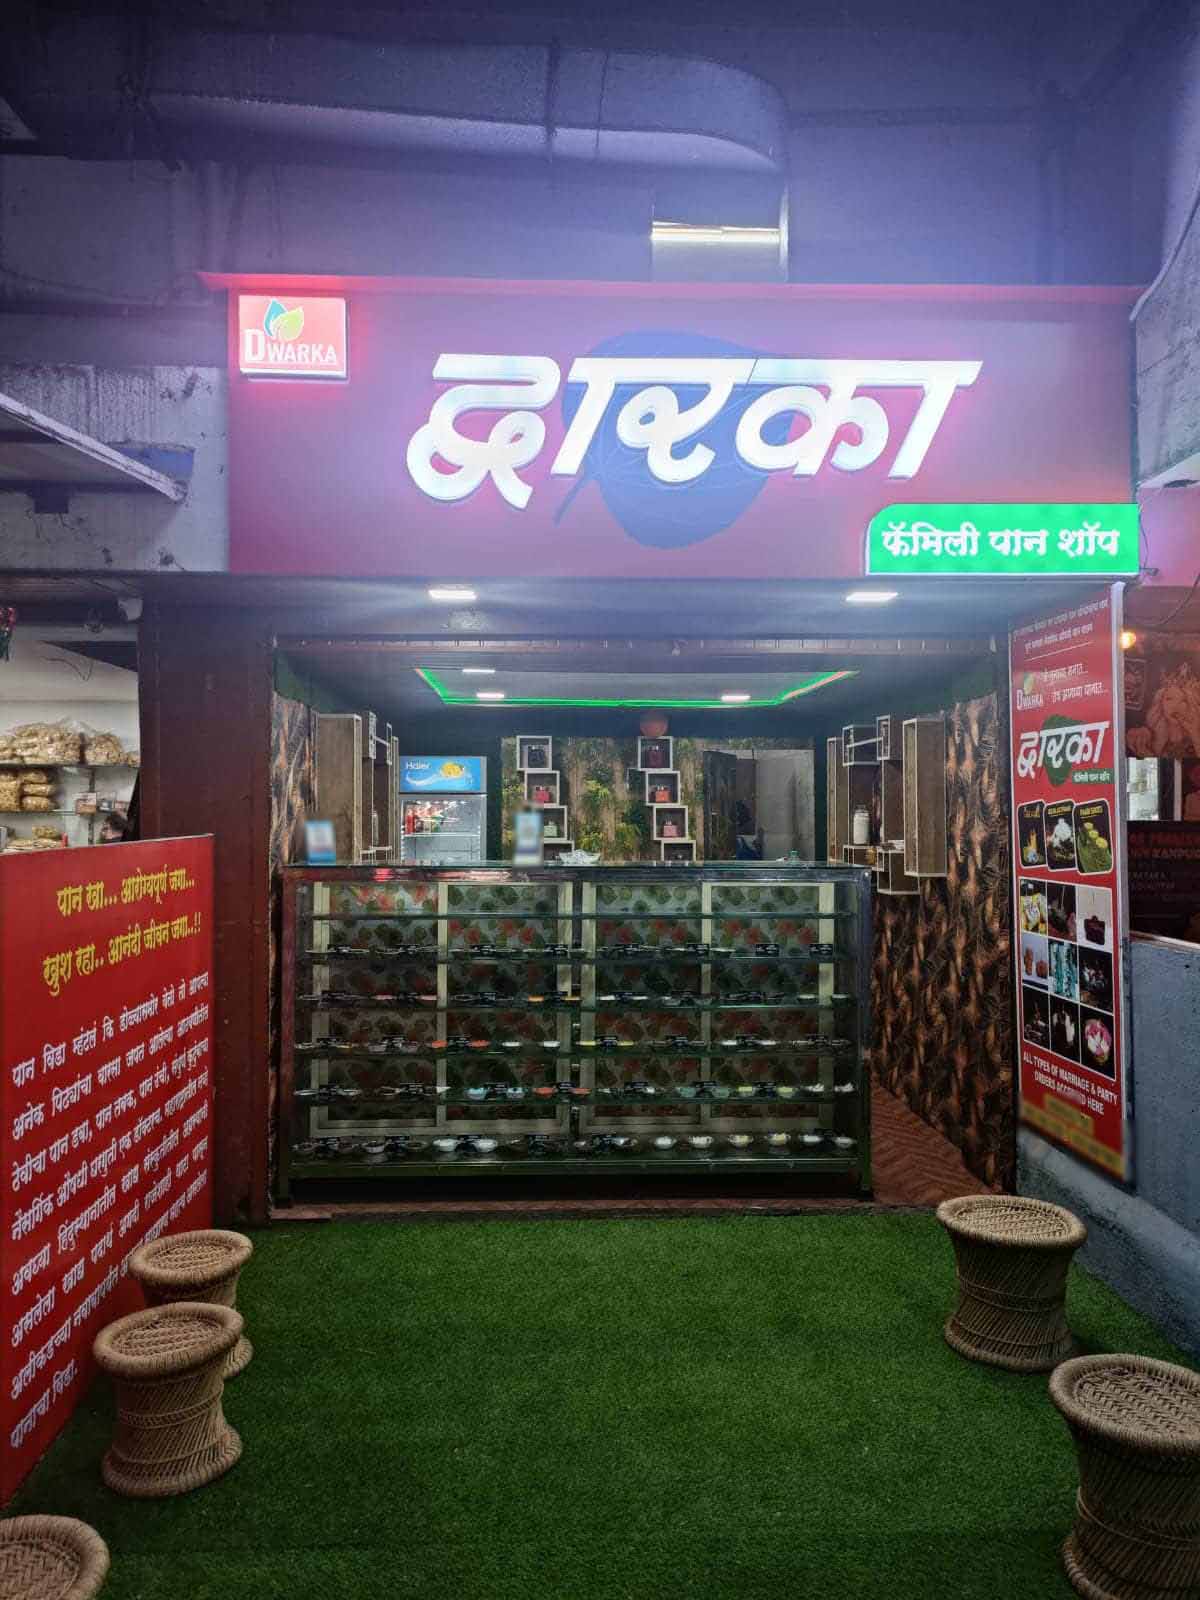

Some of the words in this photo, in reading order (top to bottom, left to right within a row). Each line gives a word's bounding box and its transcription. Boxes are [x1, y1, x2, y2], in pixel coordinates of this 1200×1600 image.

[244, 328, 338, 364] DWARKA
[881, 521, 980, 557] फॅमिली
[988, 528, 1047, 556] पान
[1056, 521, 1120, 557] शॉप
[406, 760, 430, 769] Haier
[56, 884, 82, 916] पान
[43, 951, 72, 997] खुश
[108, 923, 141, 965] आनंदी
[144, 918, 169, 950] जीवन
[12, 1057, 34, 1087] पान
[42, 1041, 65, 1073] विडा
[1023, 1051, 1033, 1065] ALL
[1033, 1055, 1051, 1073] TYPES
[1050, 1064, 1059, 1077] OF
[1058, 1067, 1090, 1092] MARRIAGE
[1097, 1085, 1118, 1105] PARTY
[1034, 1070, 1056, 1091] ORDERS
[1087, 1097, 1105, 1115] HERE
[12, 1101, 44, 1140] अनेक
[48, 1133, 68, 1162] पान
[95, 1103, 112, 1129] पान
